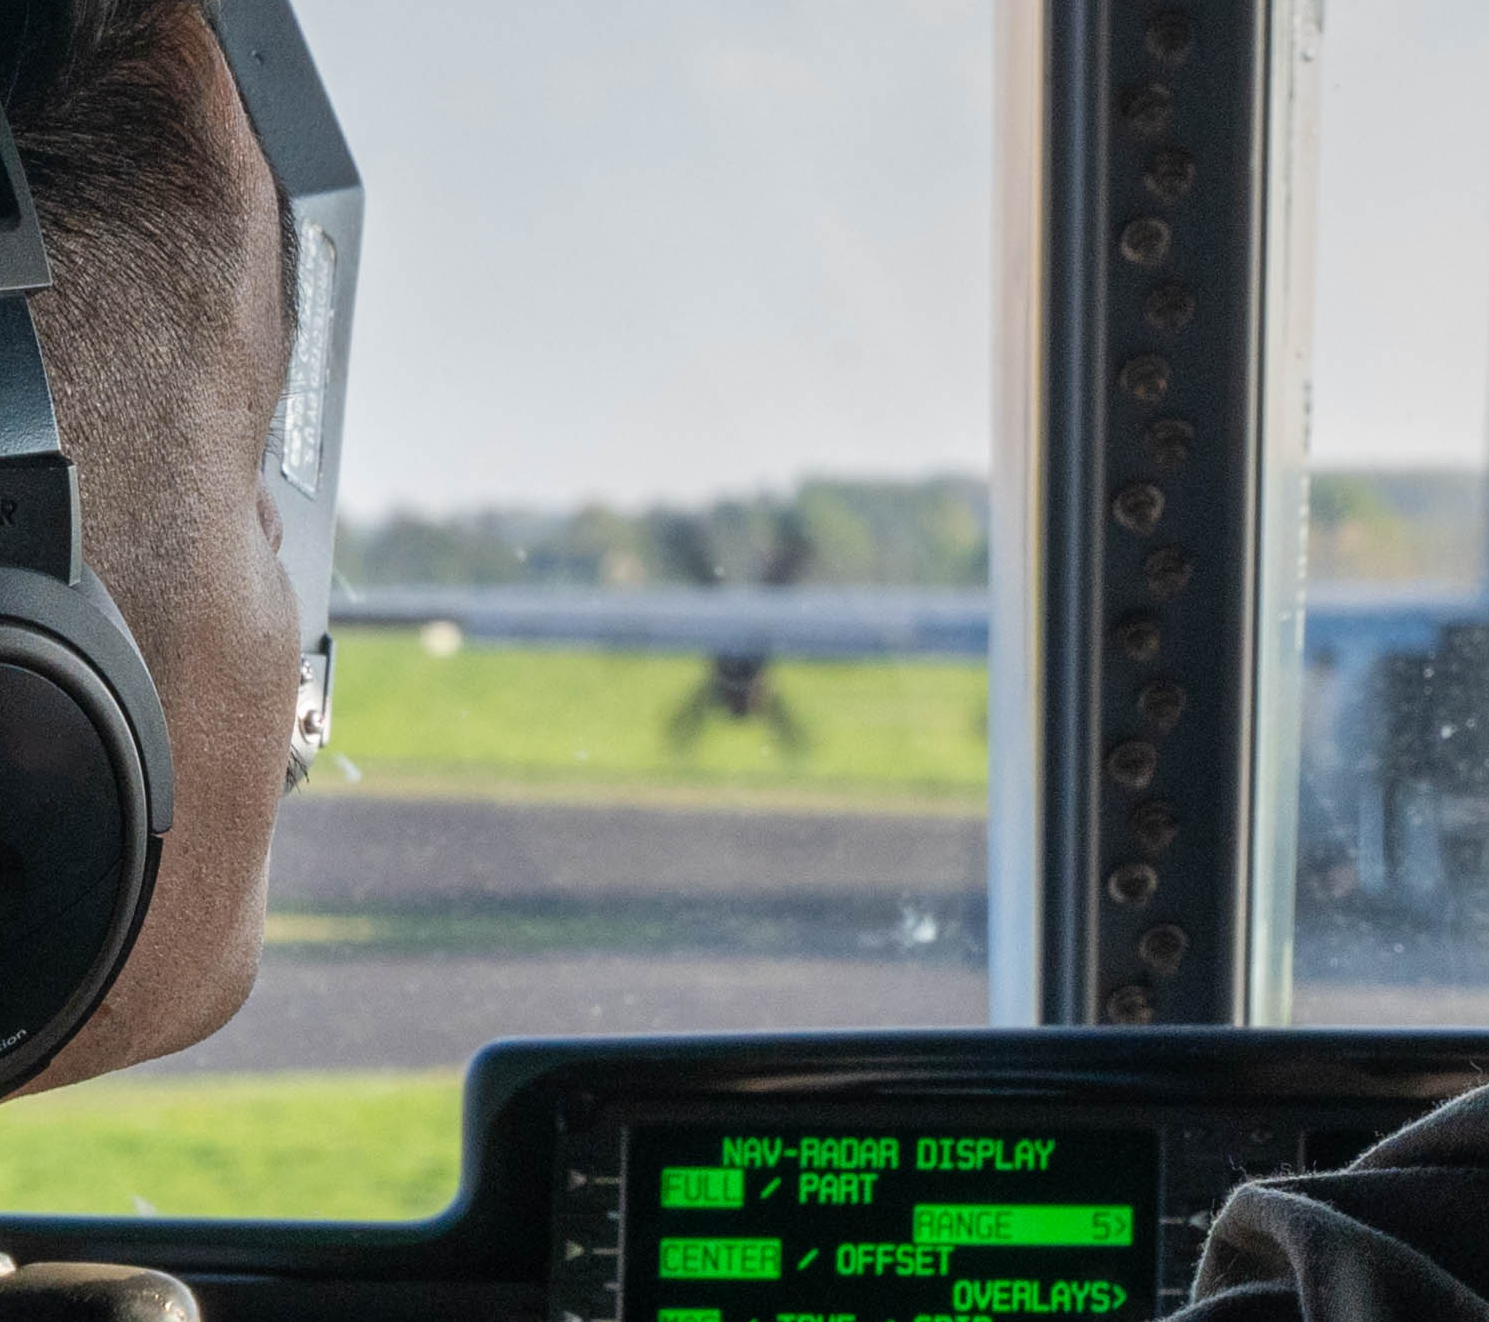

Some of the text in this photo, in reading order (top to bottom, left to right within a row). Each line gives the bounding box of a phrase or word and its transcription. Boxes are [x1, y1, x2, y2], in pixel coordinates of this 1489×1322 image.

[722, 1136, 1055, 1171] NAV-RADAR DISPLAY
[662, 1172, 879, 1205] FULL PART
[916, 1208, 1012, 1241] RANGE
[661, 1242, 956, 1277] CENTER OFFSET
